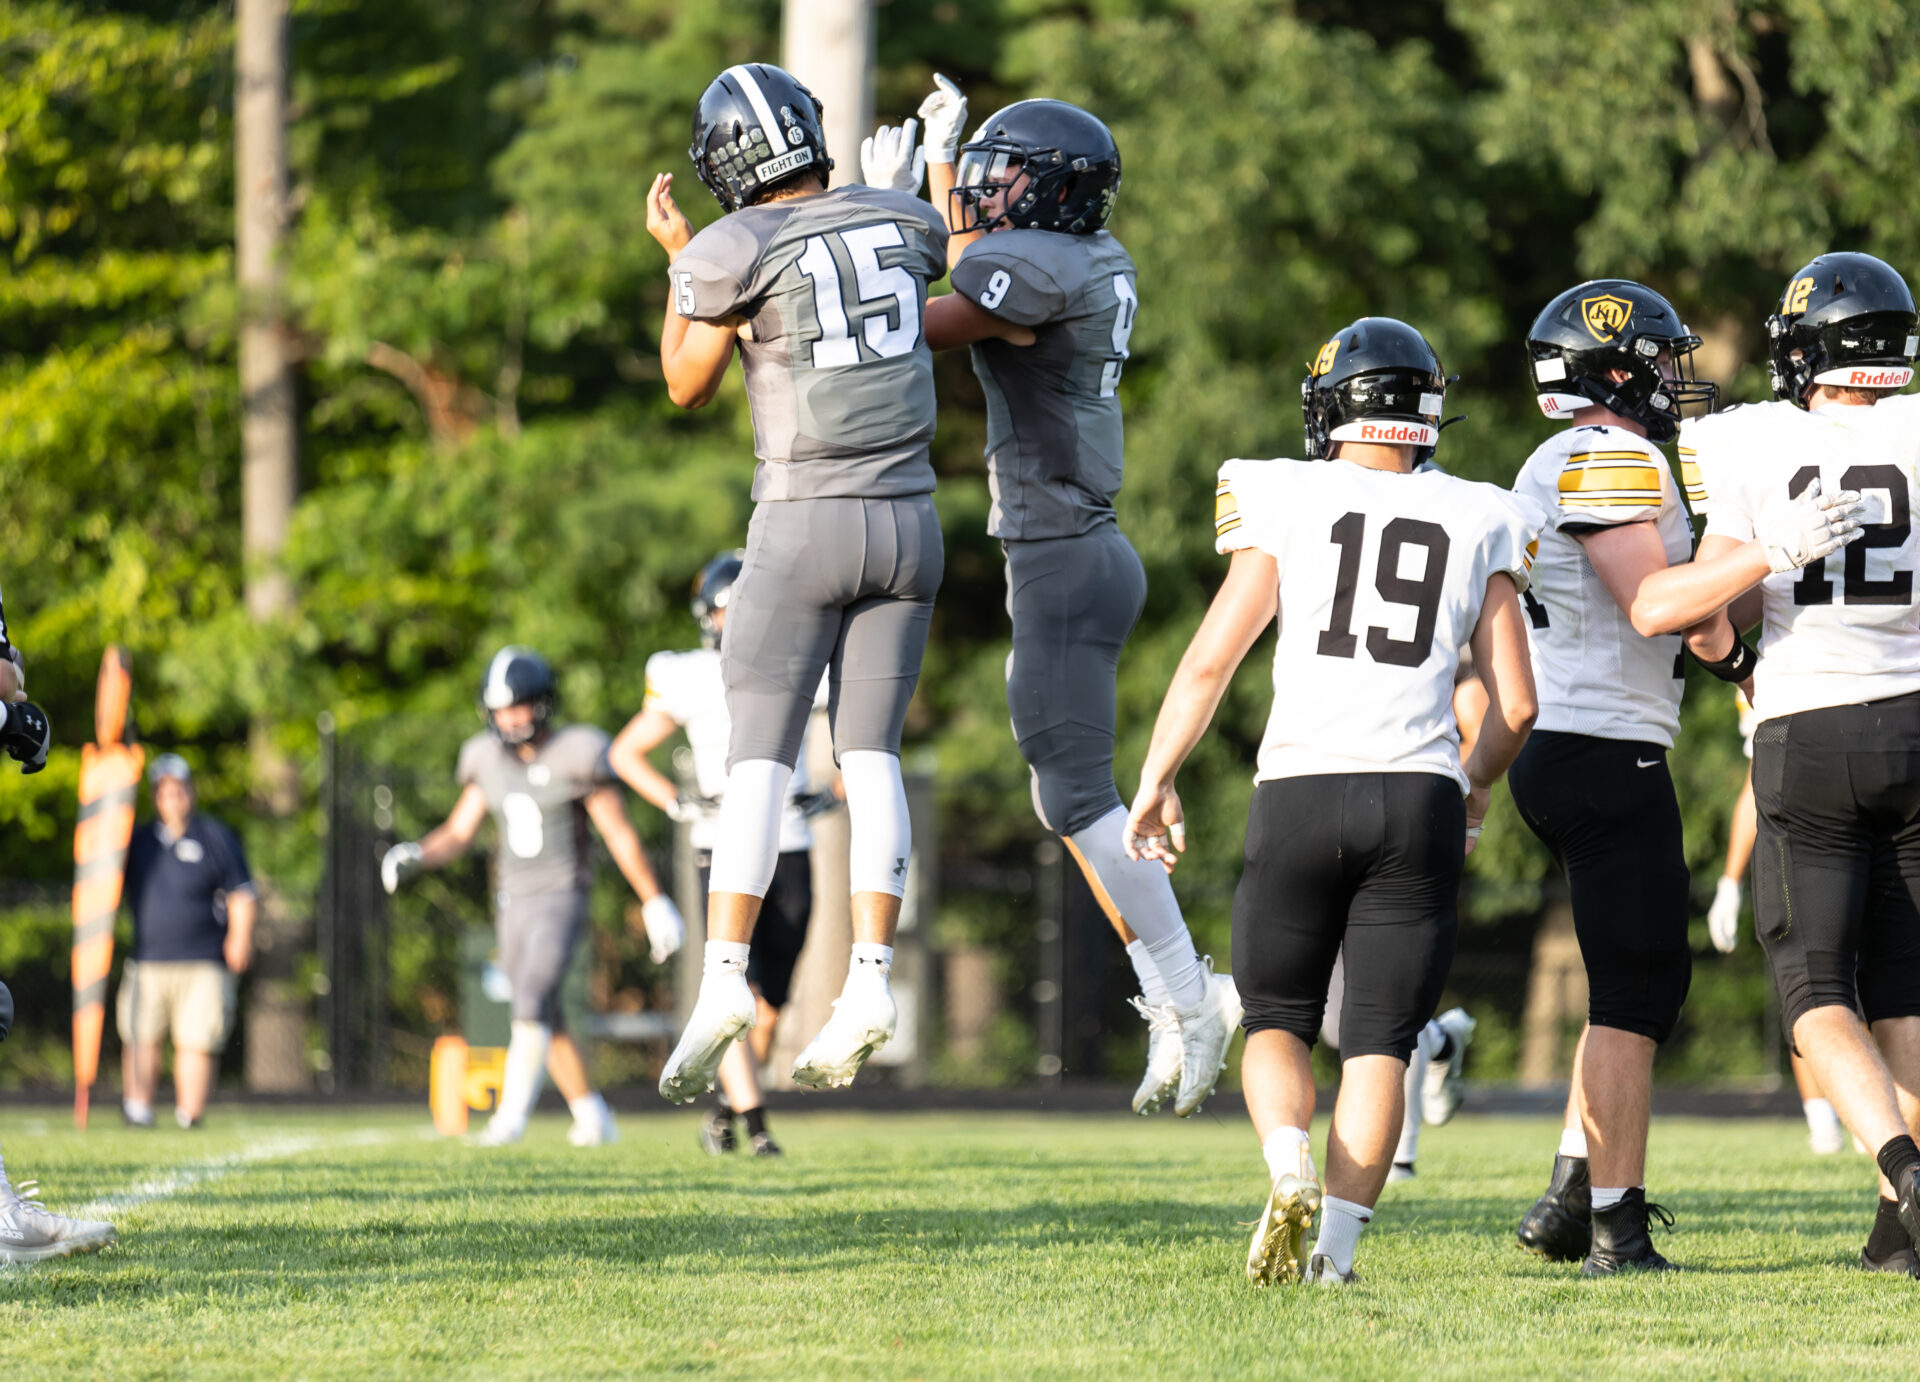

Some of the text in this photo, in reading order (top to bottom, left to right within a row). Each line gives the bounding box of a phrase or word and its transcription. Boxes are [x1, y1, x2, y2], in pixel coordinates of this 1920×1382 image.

[789, 129, 803, 143] 15
[760, 149, 810, 178] FIGHT ON
[795, 220, 921, 369] 15
[979, 268, 1013, 312] 9
[1781, 276, 1815, 317] 12
[1849, 370, 1910, 385] Riddell
[1541, 396, 1560, 414] ell
[1360, 424, 1430, 443] Riddell
[1788, 463, 1914, 606] 12
[1316, 510, 1451, 669] 19
